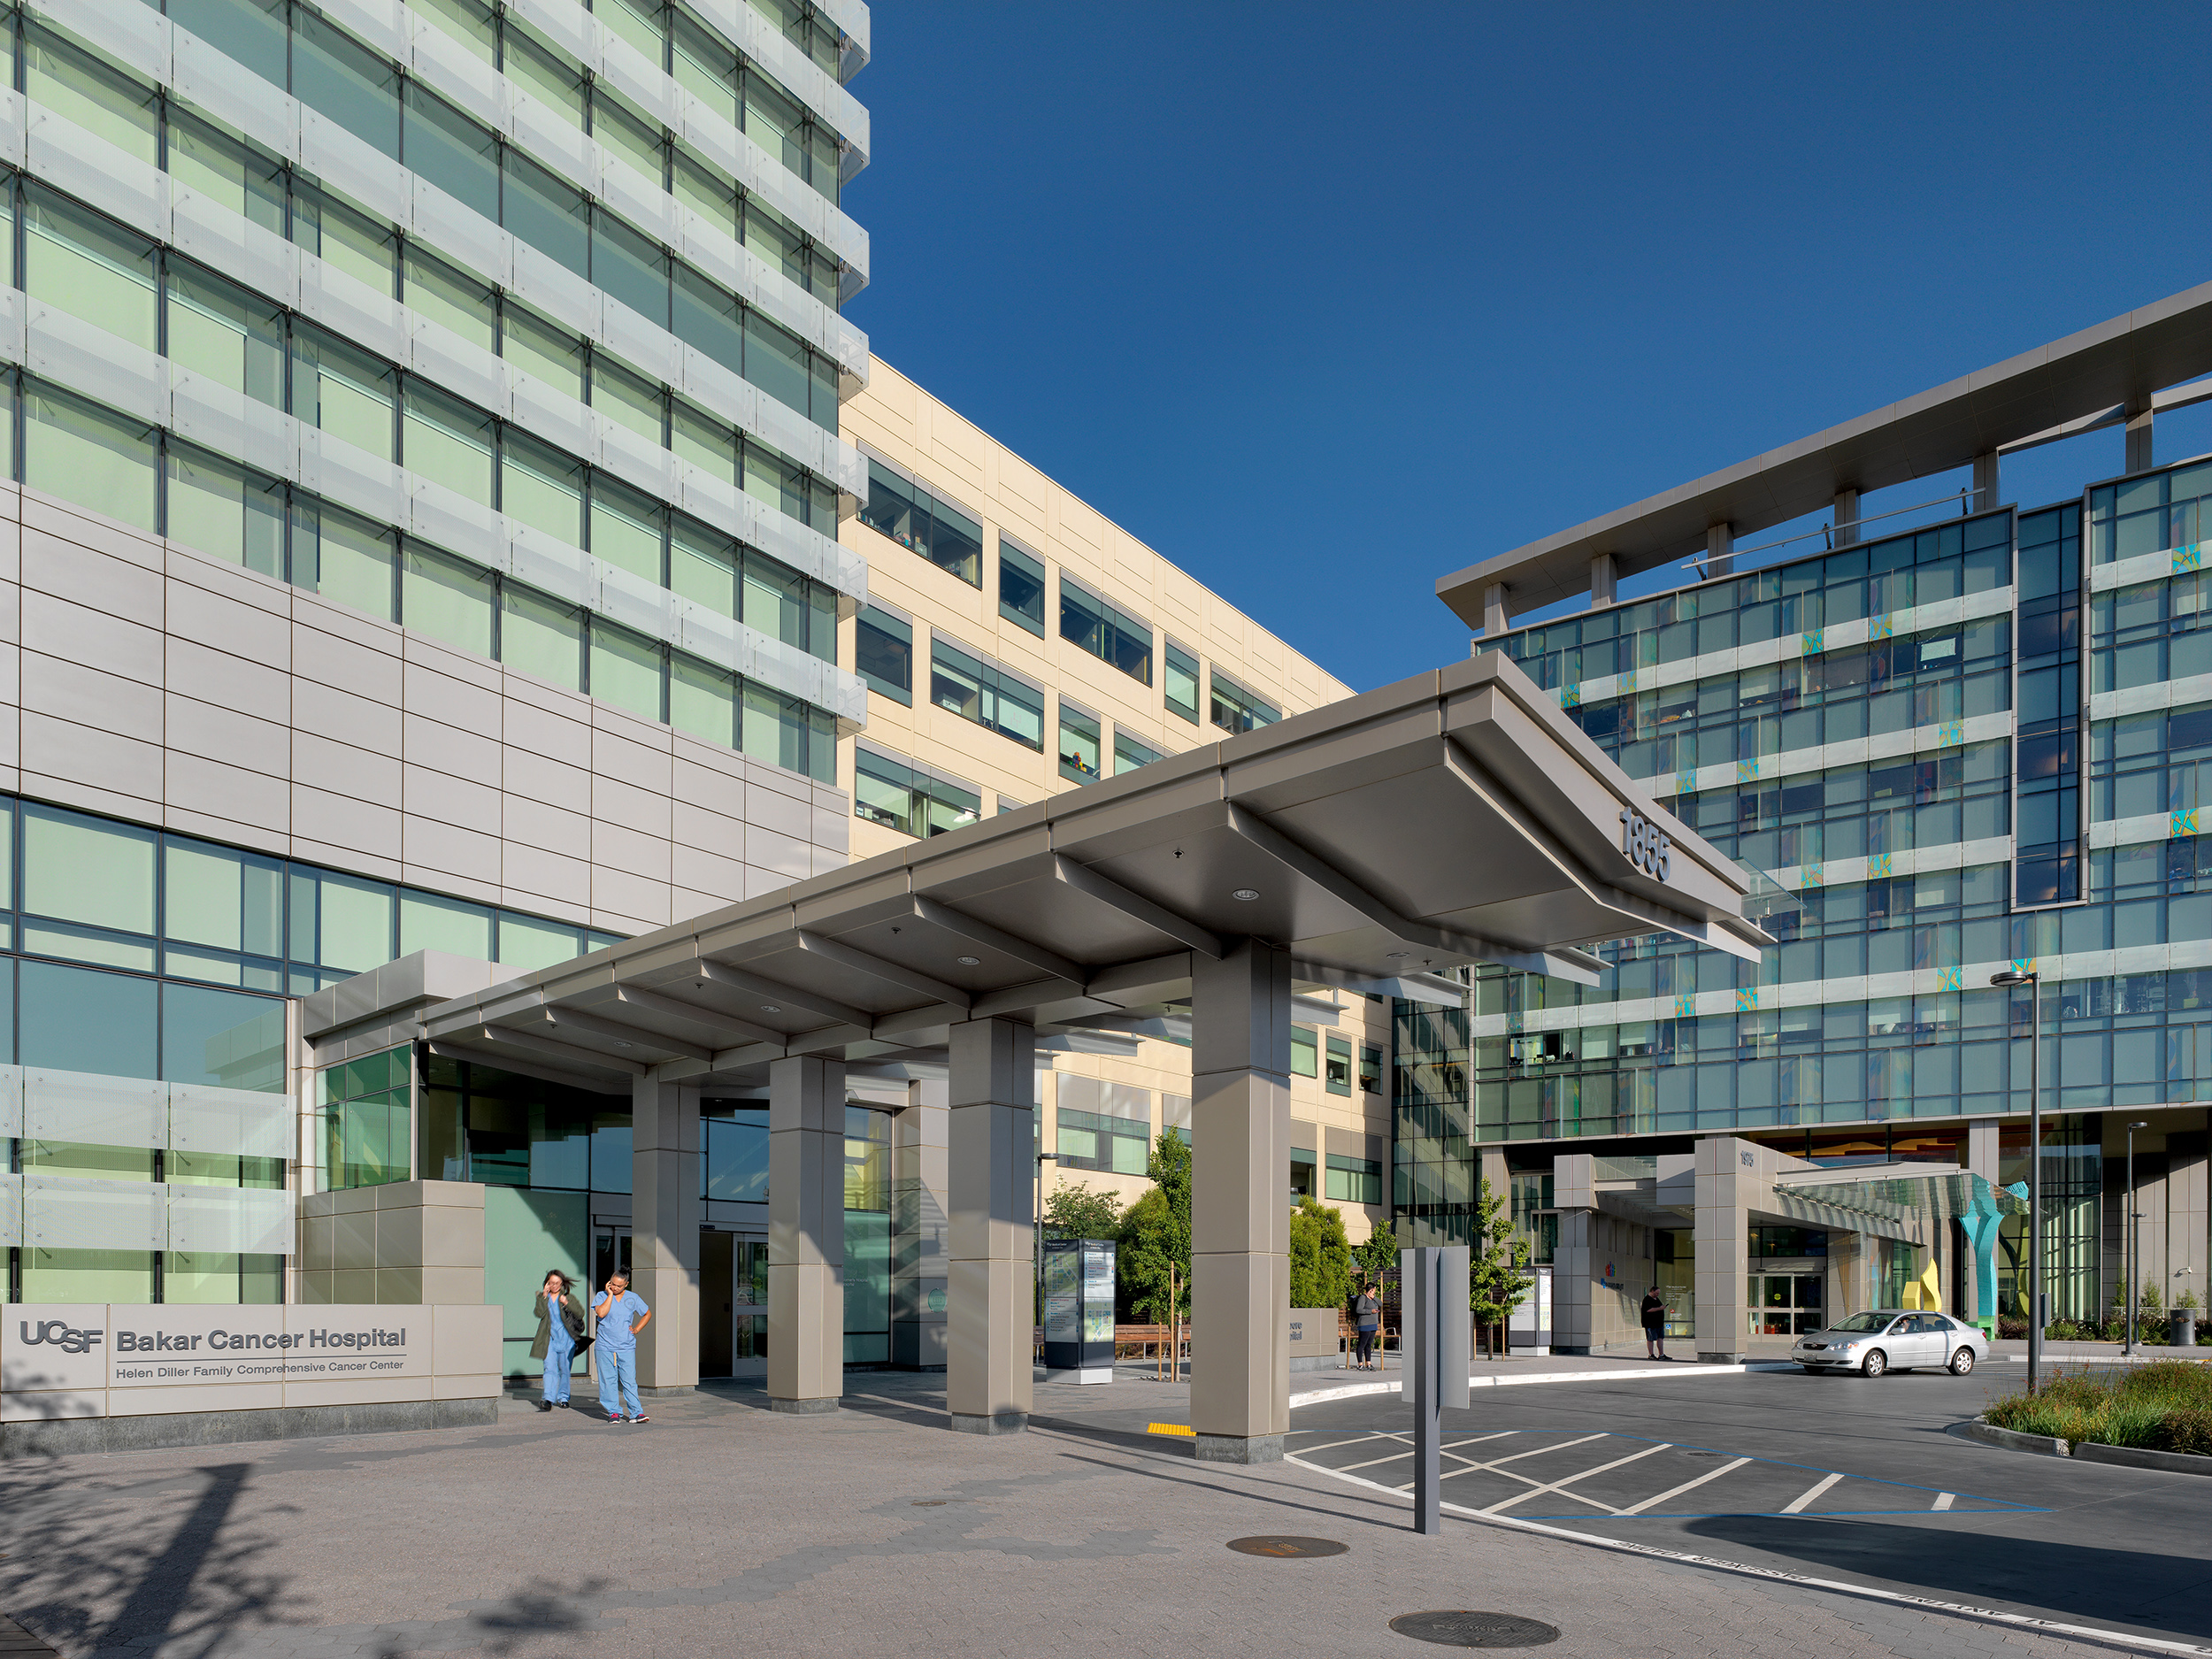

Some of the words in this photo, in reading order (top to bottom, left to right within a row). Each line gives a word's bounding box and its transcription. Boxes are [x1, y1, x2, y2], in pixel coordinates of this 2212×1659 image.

[1619, 805, 1671, 884] 1855
[1740, 1149, 1755, 1168] 1975
[19, 1319, 104, 1354] UCSF
[117, 1330, 202, 1352] Bakar
[207, 1329, 304, 1350] Cancer
[309, 1327, 406, 1351] Hospital
[1289, 1330, 1302, 1342] pital
[116, 1368, 154, 1379] Helen
[157, 1366, 190, 1378] Diller
[193, 1365, 234, 1378] Family
[236, 1363, 326, 1376] Comprehensive
[328, 1361, 367, 1372] Cancer
[369, 1360, 404, 1371] Center
